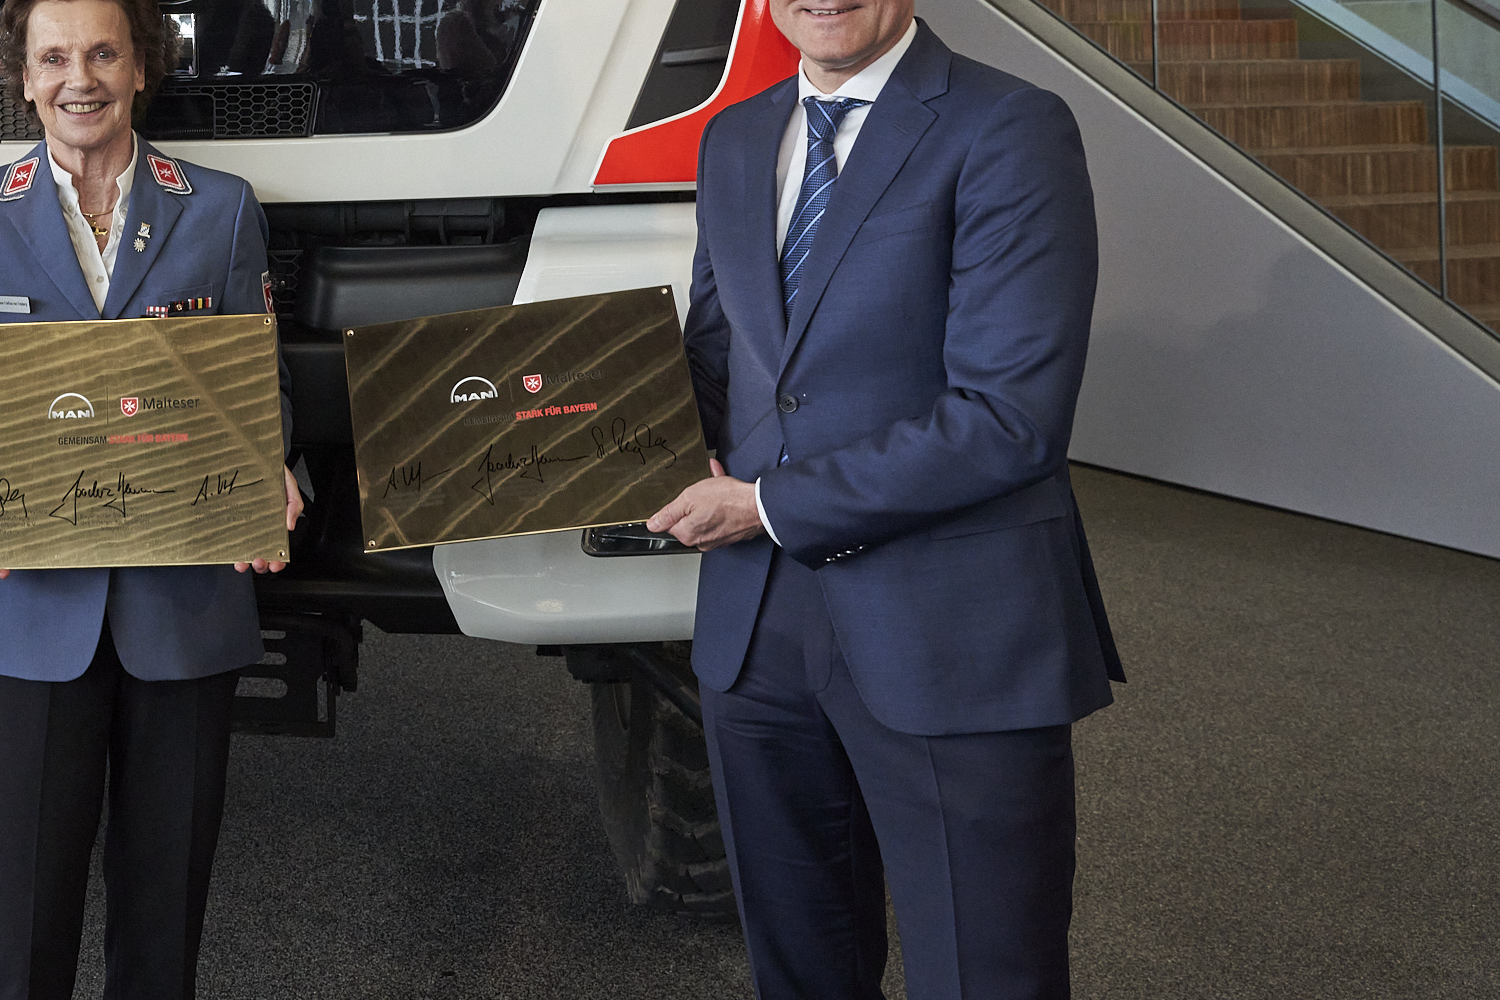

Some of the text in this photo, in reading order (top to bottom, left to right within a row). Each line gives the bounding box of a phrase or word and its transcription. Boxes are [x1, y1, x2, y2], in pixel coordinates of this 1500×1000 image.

[143, 396, 200, 410] Malteser
[454, 390, 493, 403] MAN
[52, 409, 90, 419] MAN
[516, 408, 543, 420] STARK
[545, 405, 561, 416] FÜR
[564, 402, 597, 414] BAYERN
[58, 432, 188, 445] GEMEINSAM STARK FÜR BAYERN
